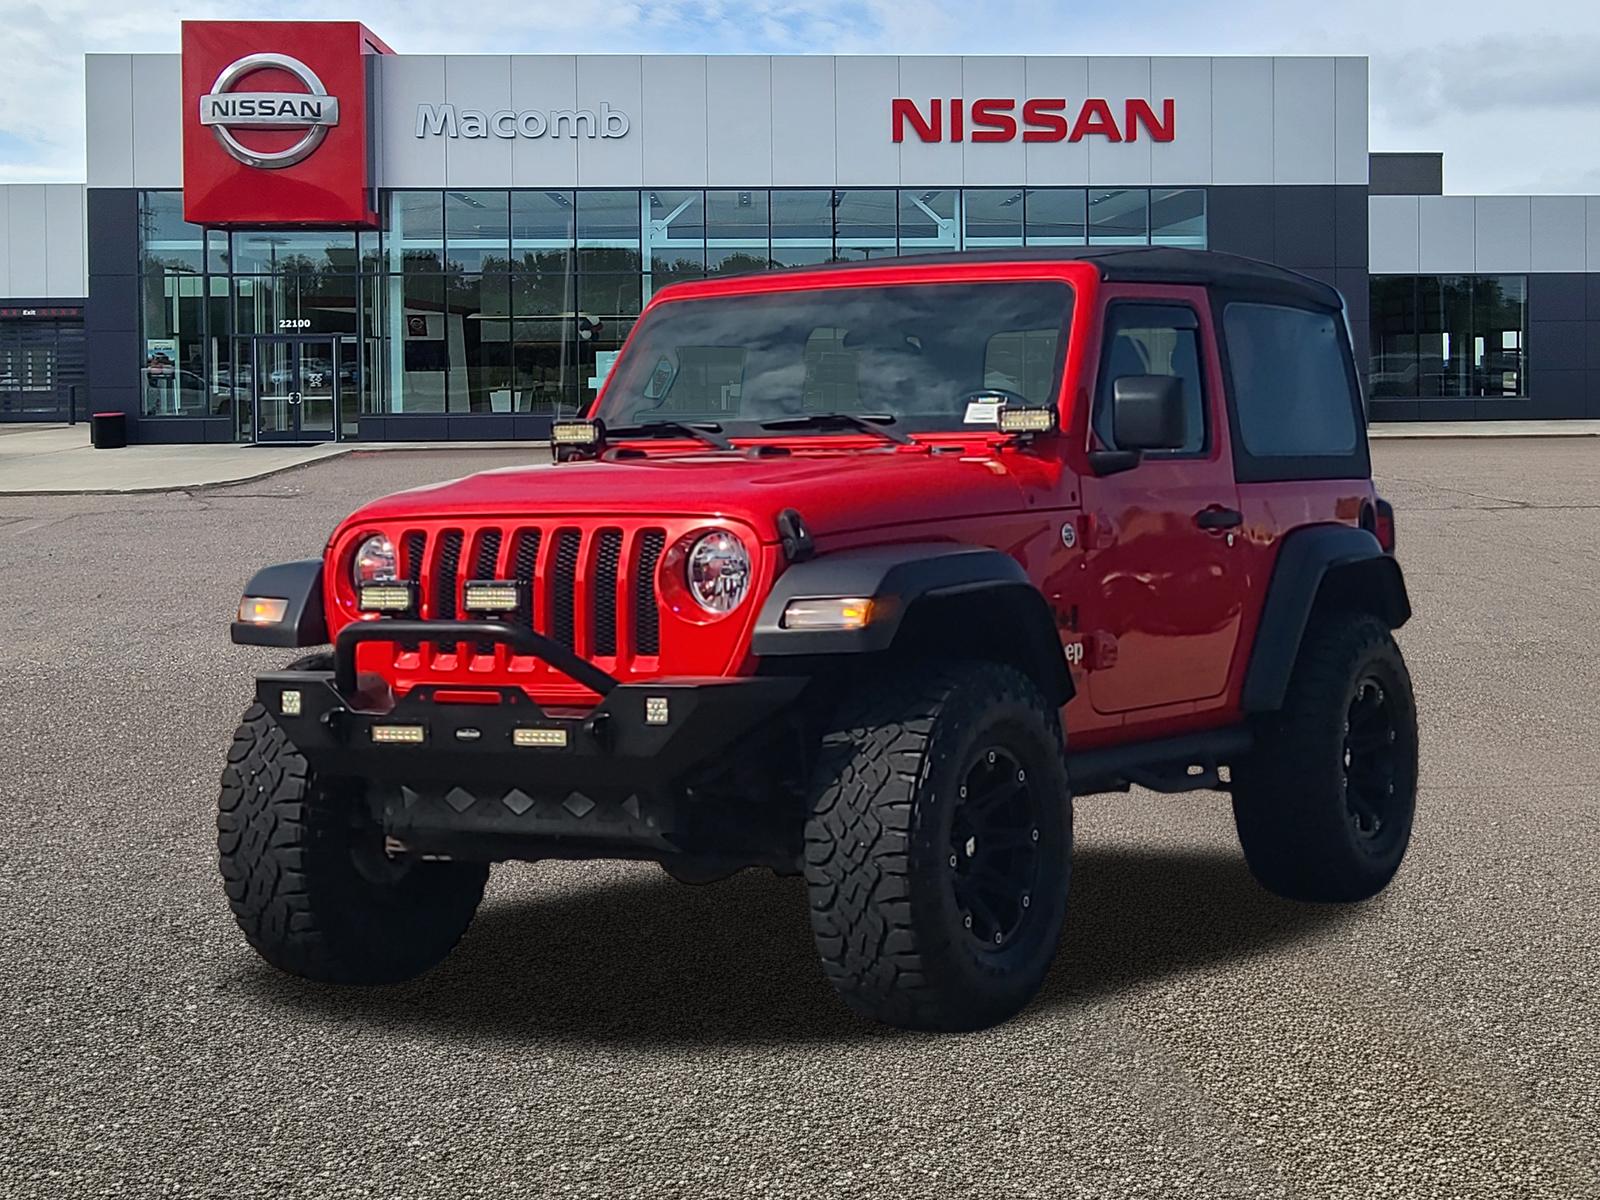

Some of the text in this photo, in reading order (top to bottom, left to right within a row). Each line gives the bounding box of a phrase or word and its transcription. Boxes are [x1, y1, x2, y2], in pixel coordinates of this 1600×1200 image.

[211, 99, 322, 118] NISSAN
[415, 101, 630, 139] Macomb
[892, 98, 1175, 143] NISSAN
[279, 319, 311, 328] 22100
[1064, 642, 1084, 665] ep
